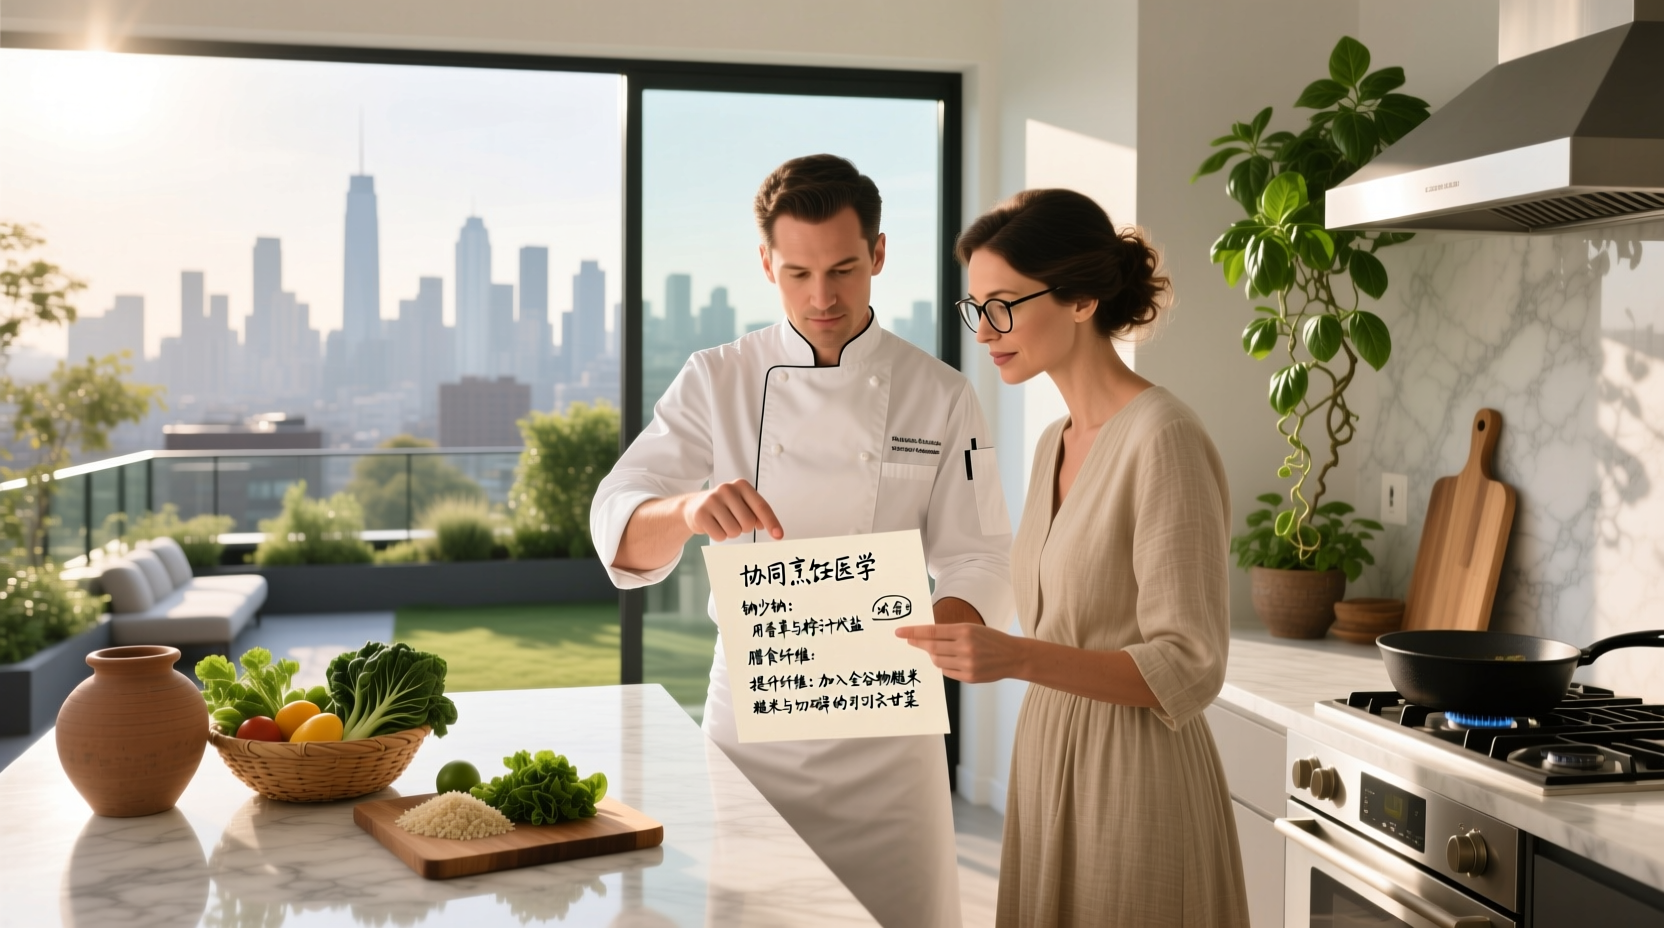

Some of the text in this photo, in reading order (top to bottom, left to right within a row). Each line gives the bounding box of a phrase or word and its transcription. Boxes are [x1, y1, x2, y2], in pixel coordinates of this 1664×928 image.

[739, 551, 876, 588] 协同烹饪医学
